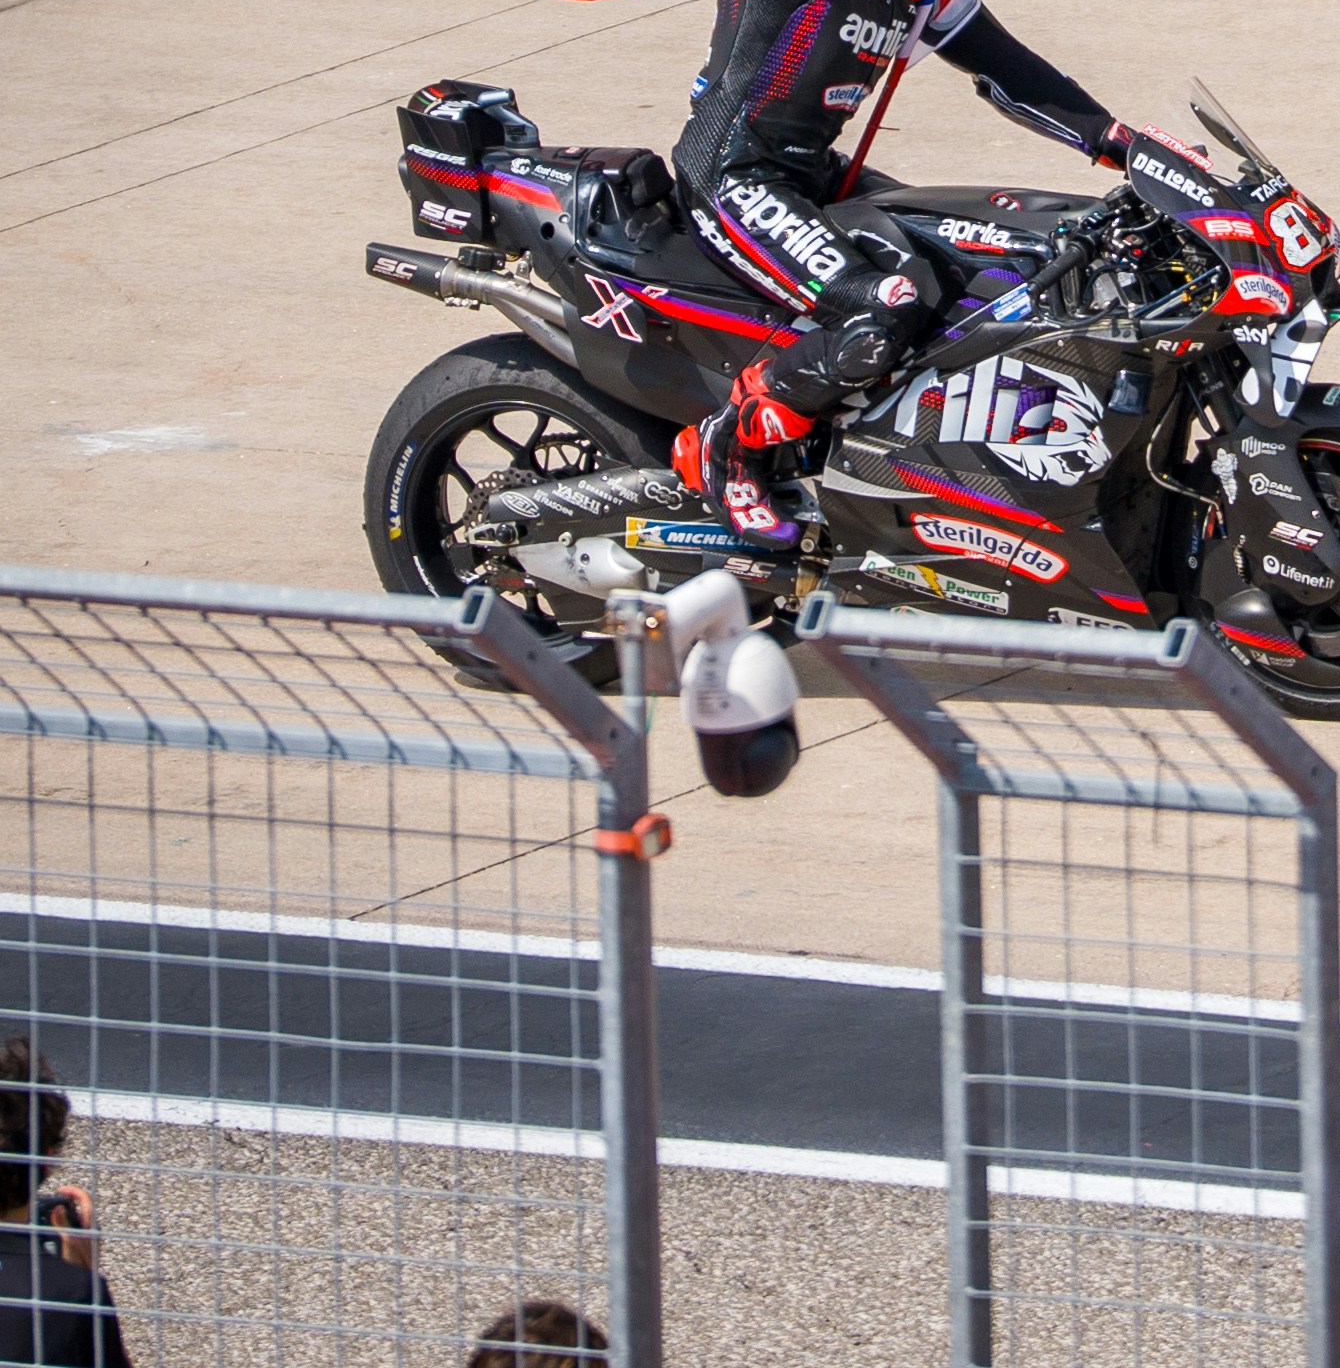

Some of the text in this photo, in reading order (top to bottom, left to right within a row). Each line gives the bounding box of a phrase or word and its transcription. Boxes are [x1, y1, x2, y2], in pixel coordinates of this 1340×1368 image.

[420, 200, 472, 227] SC
[729, 183, 847, 284] aprilia
[937, 218, 1011, 249] aprilia
[1204, 219, 1255, 236] BS
[375, 257, 418, 278] SC
[1239, 277, 1288, 308] sterilgarda
[1233, 324, 1269, 346] sky
[390, 445, 414, 514] MICHELIN
[1272, 521, 1325, 545] SC
[921, 520, 1054, 573] sterilgarda
[723, 556, 777, 575] SC
[1279, 564, 1336, 589] Lifenet.it
[946, 580, 1000, 604] Power
